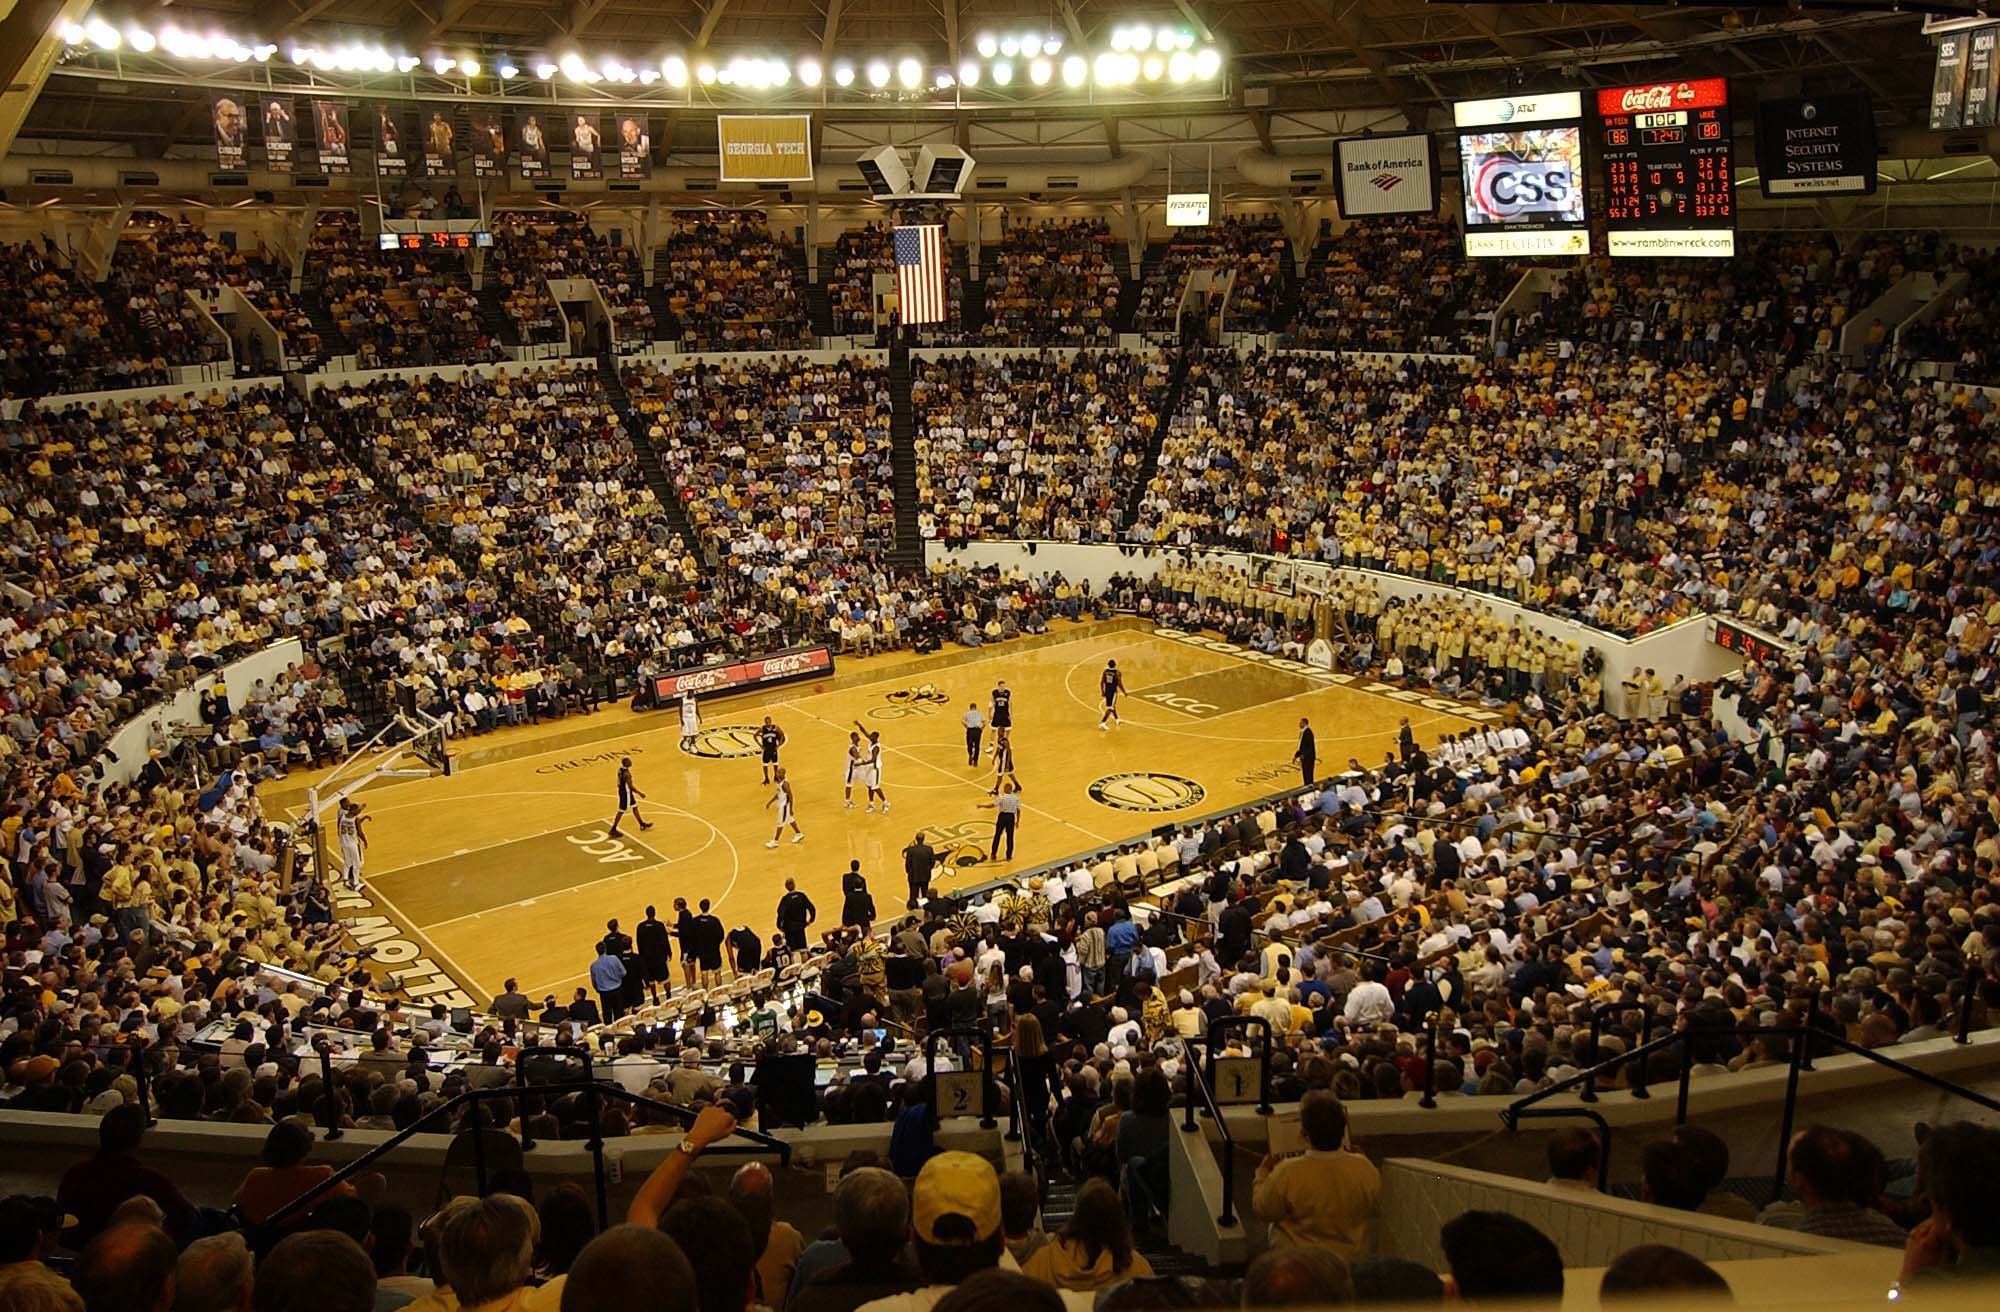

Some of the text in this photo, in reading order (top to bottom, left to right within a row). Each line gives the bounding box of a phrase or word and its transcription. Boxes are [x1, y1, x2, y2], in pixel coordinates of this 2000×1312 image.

[1622, 86, 1673, 111] Coca-Cola
[1517, 104, 1537, 113] AT&T
[1612, 131, 1626, 143] 86
[1703, 124, 1718, 137] 80
[1786, 126, 1839, 140] INTERNET
[727, 142, 805, 155] GEORGIA TECH
[1785, 143, 1840, 157] SECURITY
[1347, 158, 1423, 172] Bank of America
[1786, 160, 1843, 173] SYSTEMS
[1490, 171, 1567, 205] CSS
[763, 654, 801, 675] Coca-Cola
[1153, 628, 1357, 684] GEORGIA
[676, 669, 716, 692] Coca-Cola
[1144, 692, 1220, 714] ACC
[1361, 682, 1503, 720] TECH
[565, 830, 645, 864] ACC
[776, 954, 790, 968] 10
[952, 1087, 968, 1112] 2
